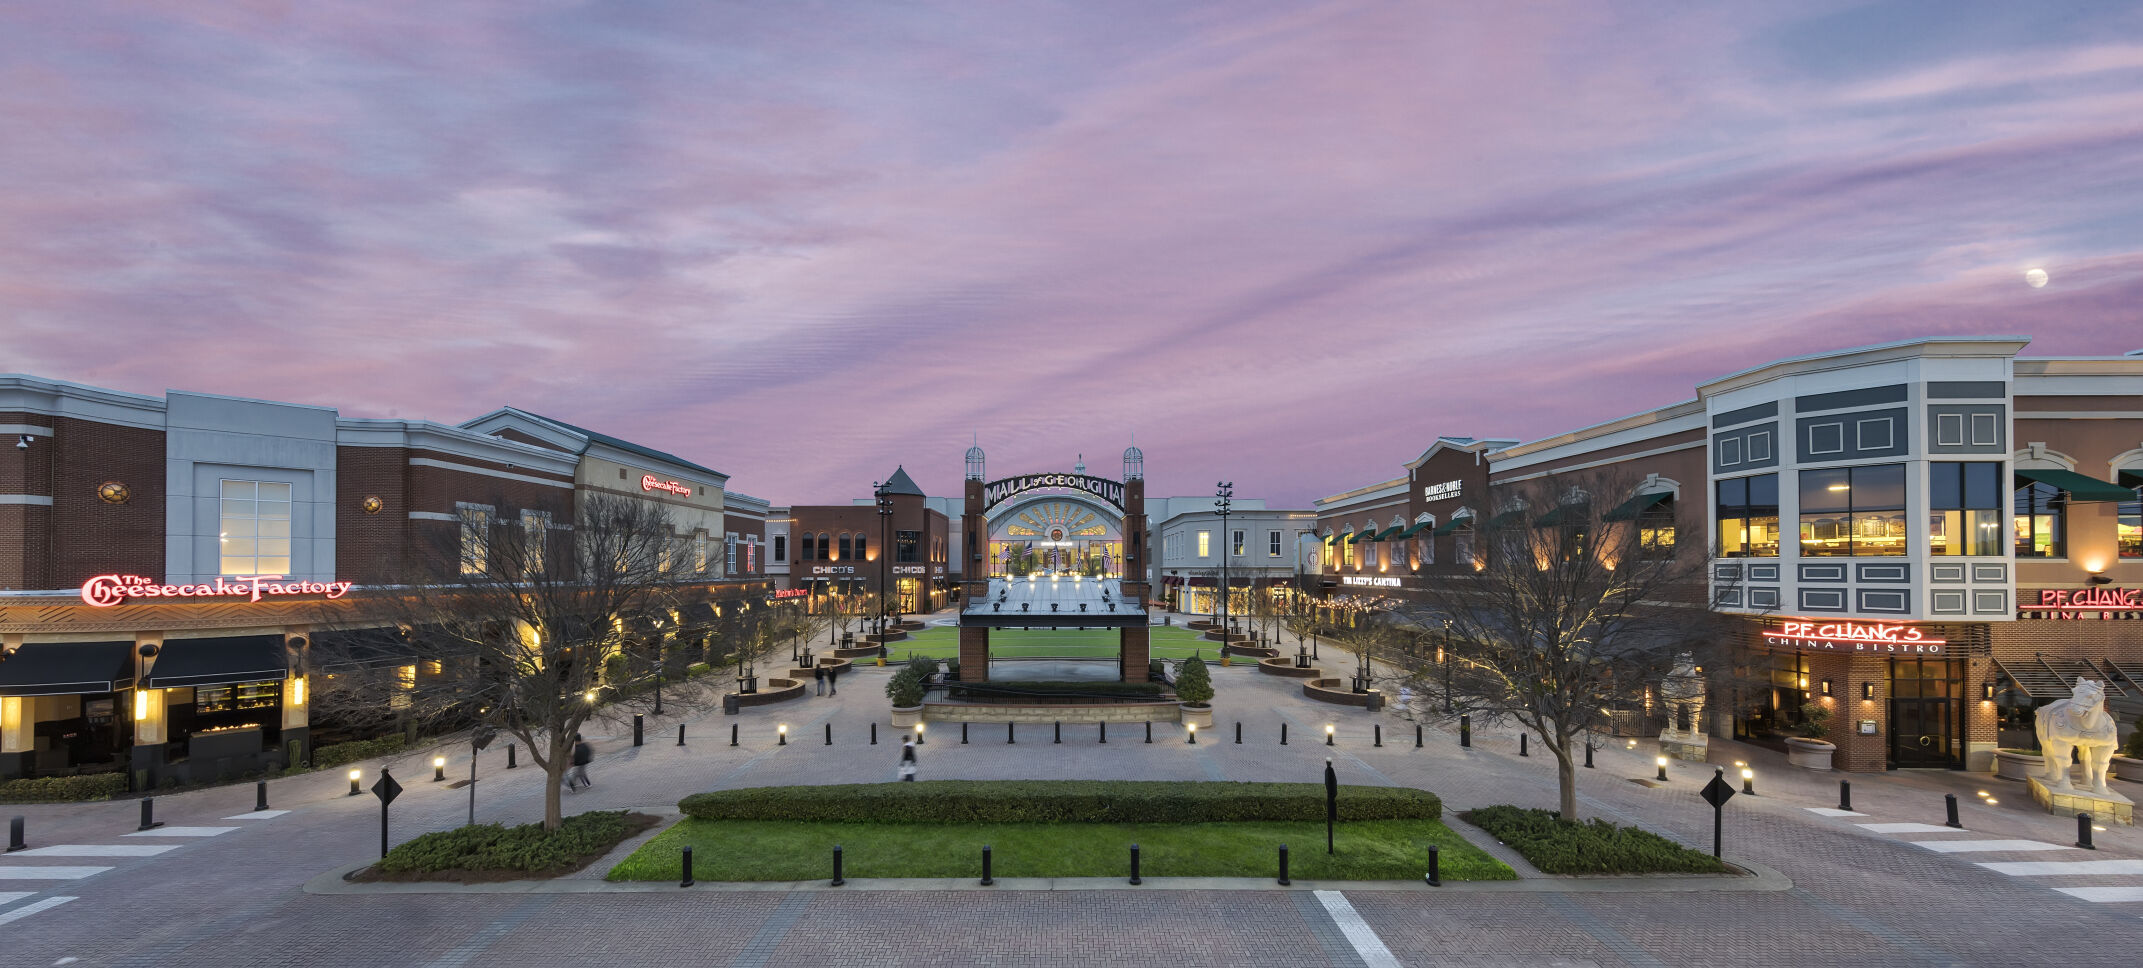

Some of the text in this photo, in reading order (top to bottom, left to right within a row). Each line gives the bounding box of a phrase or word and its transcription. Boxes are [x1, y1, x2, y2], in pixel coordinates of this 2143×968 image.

[642, 475, 691, 497] Cheesecake Factory
[987, 478, 1030, 503] MALL
[1044, 475, 1122, 505] GEORGIA
[1425, 490, 1461, 503] BOOKSELLERS
[812, 566, 855, 574] CHICO'S
[121, 575, 152, 586] The
[1373, 577, 1402, 587] CANTINA
[80, 574, 352, 608] Cheesecake Factory
[2042, 589, 2070, 609] P.F.
[1784, 622, 1923, 644] P.F. CHANG'S
[1768, 636, 1939, 653] CHINA BISTRO
